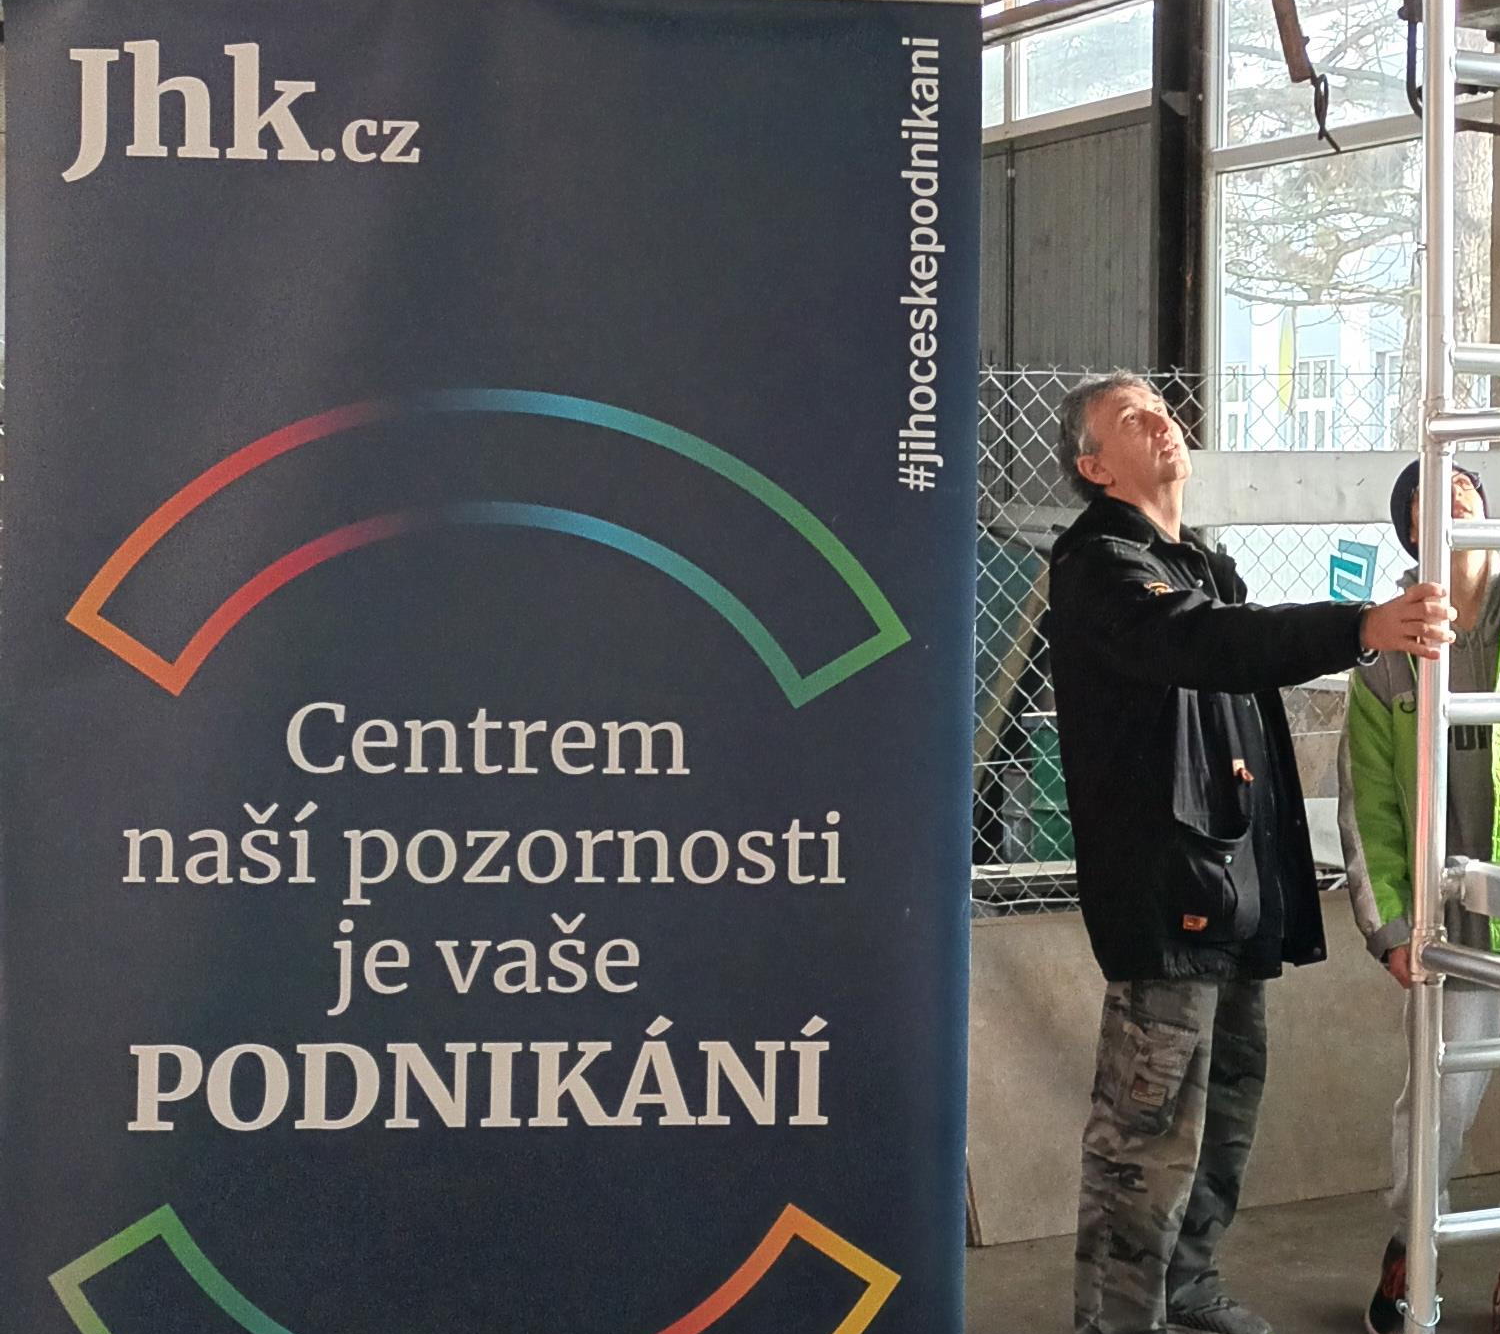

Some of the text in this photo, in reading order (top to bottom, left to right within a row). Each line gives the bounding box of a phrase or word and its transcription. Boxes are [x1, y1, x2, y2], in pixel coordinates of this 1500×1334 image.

[62, 39, 421, 183] Jhk.cz
[899, 36, 946, 493] #jihoceskepodnikani
[286, 701, 691, 775] Centrem
[123, 801, 846, 906] naší pozornosti
[327, 912, 641, 1016] je vaše
[127, 1015, 830, 1133] PODNIKÁNÍ
